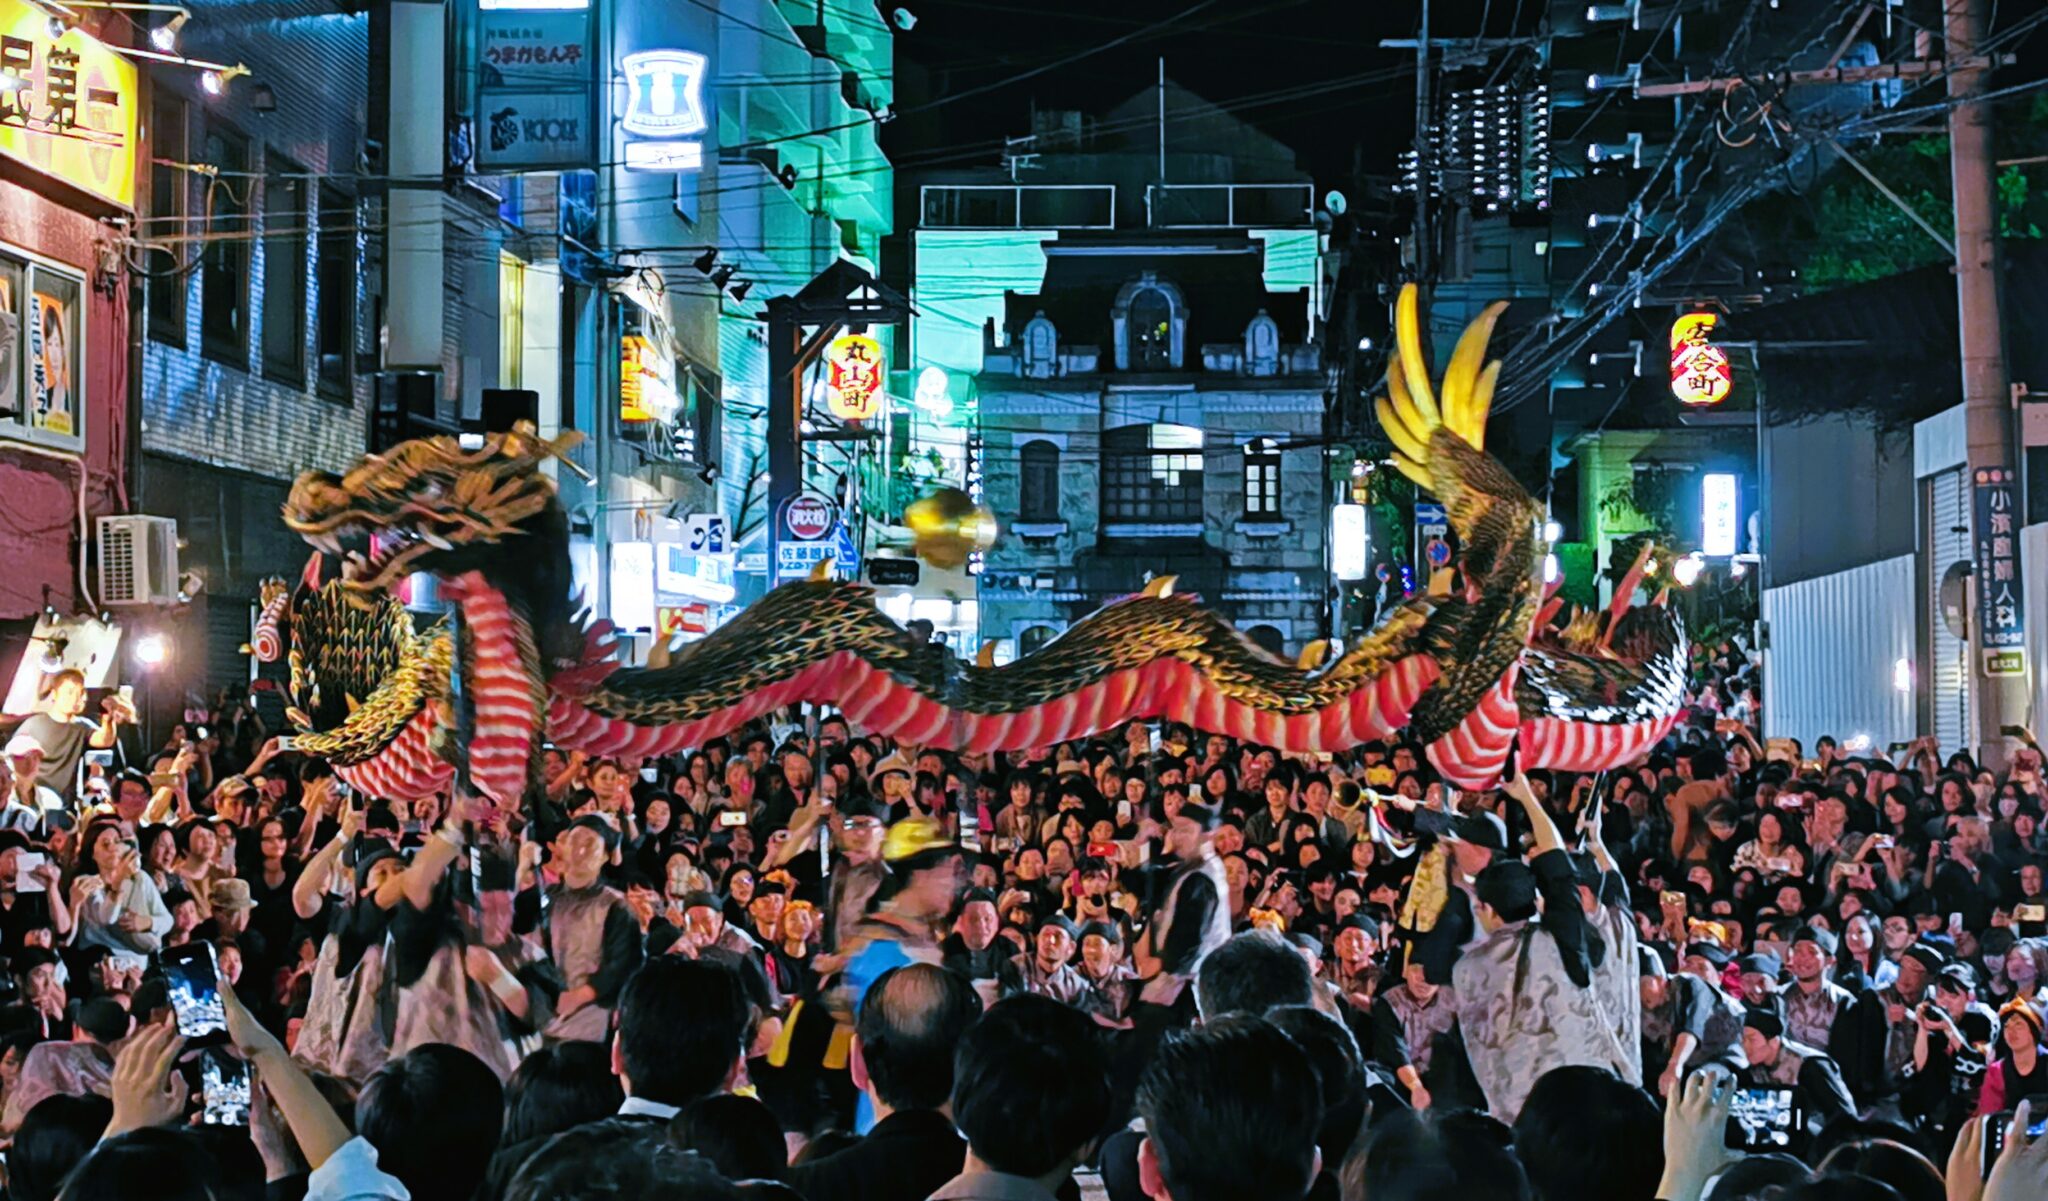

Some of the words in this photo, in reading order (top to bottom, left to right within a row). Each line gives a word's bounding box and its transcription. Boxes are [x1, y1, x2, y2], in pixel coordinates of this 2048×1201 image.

[486, 43, 583, 64] うまかもん亭
[841, 341, 872, 413] 丸山町
[791, 508, 826, 526] 消火栓
[782, 546, 837, 561] 佐藤眼科
[1990, 489, 2017, 628] 小濱産婦人科
